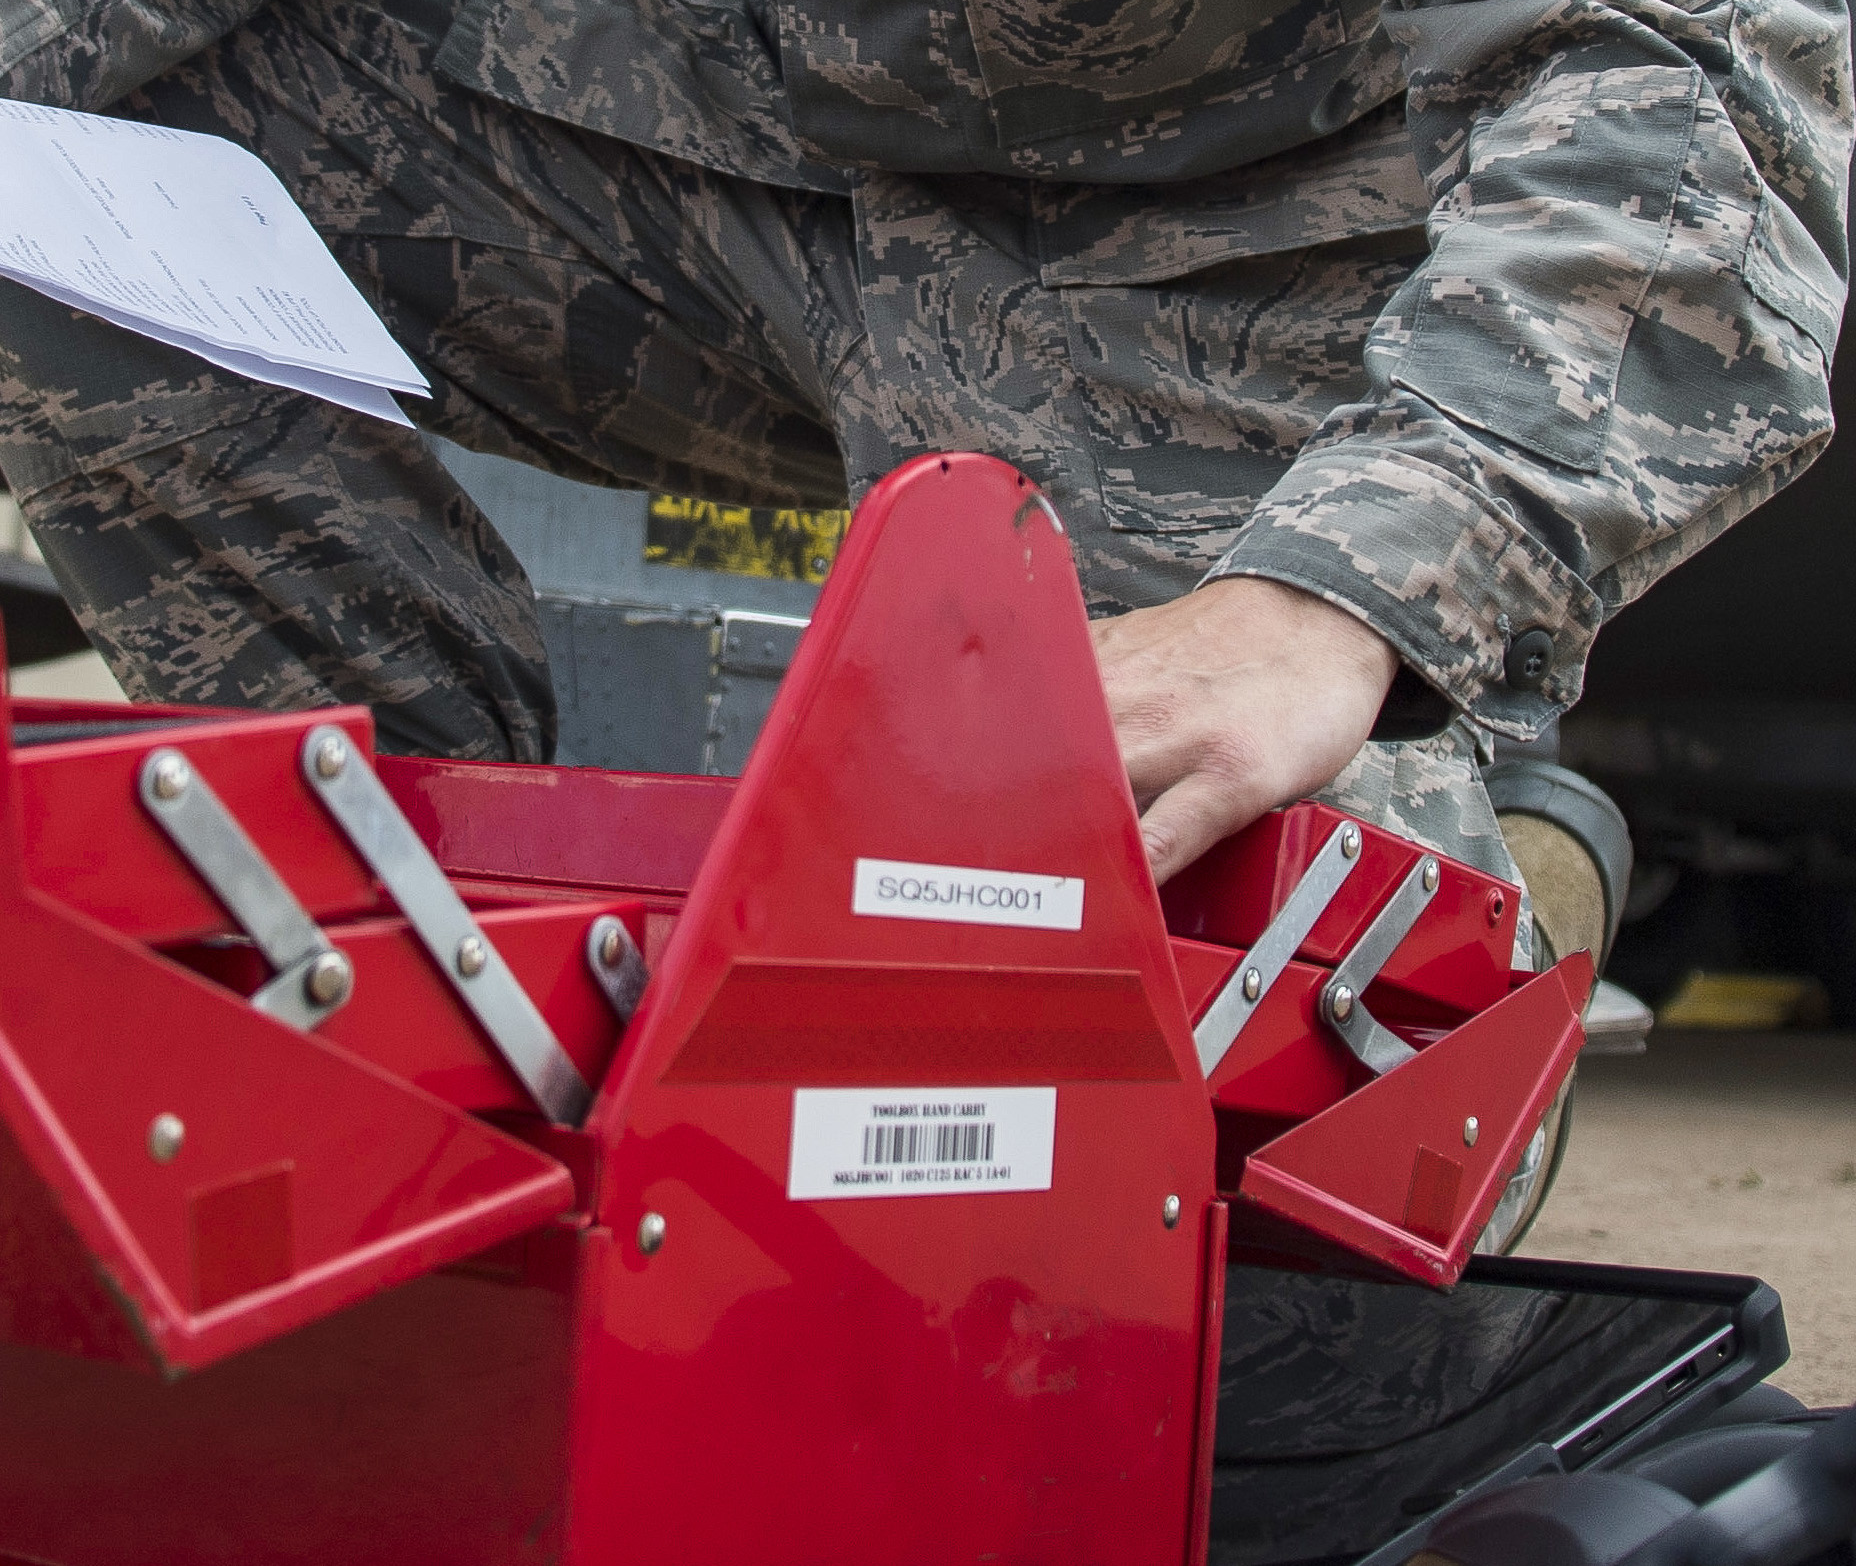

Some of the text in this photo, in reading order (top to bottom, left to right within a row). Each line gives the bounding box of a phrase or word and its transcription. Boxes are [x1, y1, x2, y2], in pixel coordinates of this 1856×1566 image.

[877, 875, 1043, 911] SQ5JHC001
[872, 1103, 987, 1118] TOOLBOX HAND CARRY
